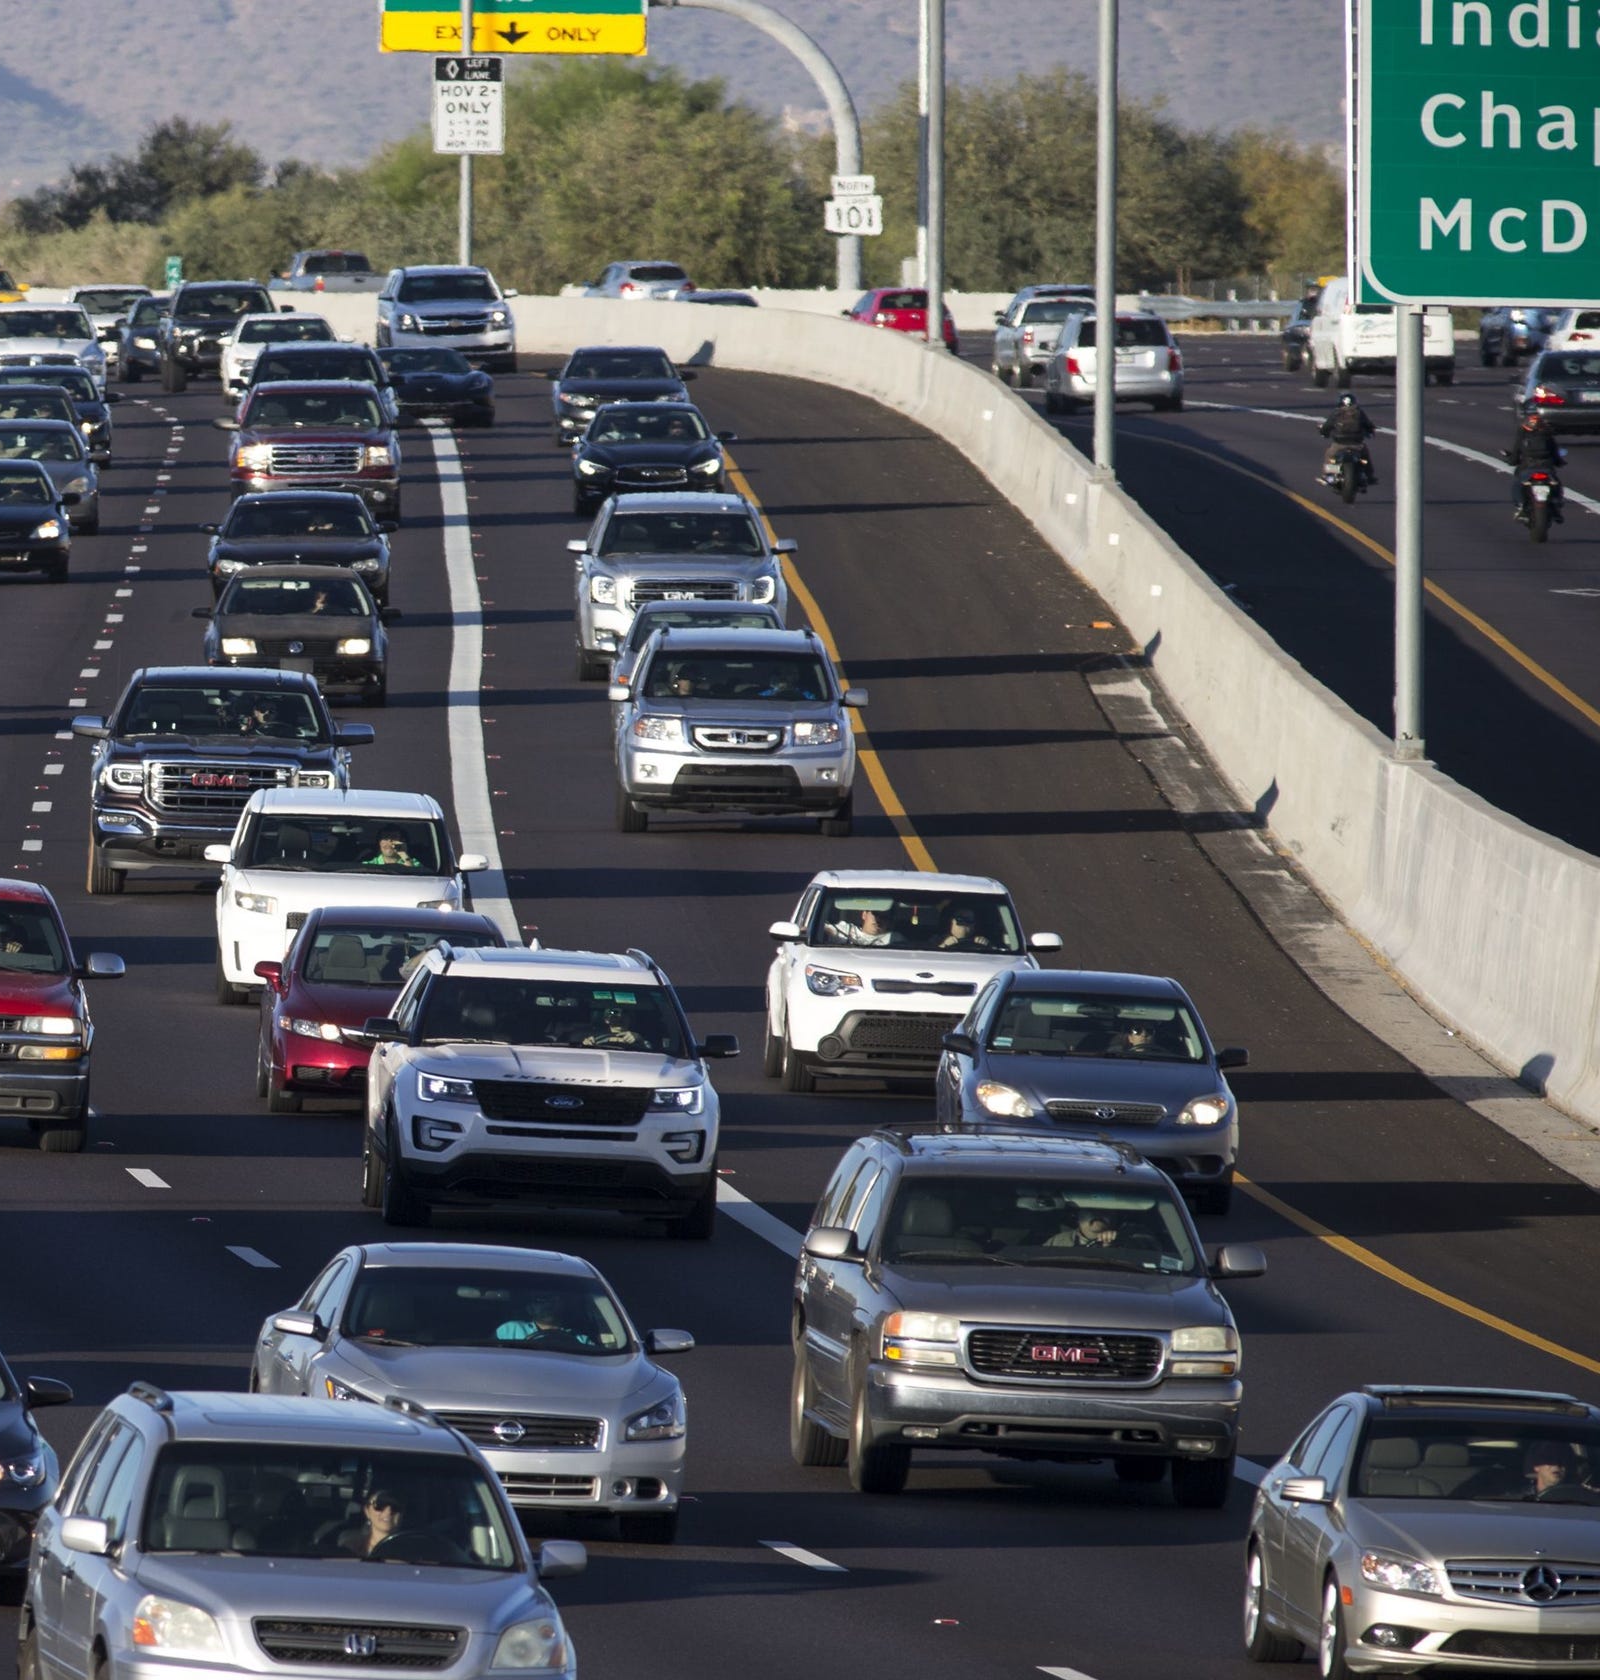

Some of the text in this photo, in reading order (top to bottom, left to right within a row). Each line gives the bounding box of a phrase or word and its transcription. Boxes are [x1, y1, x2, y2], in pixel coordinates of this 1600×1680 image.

[1420, 0, 1600, 49] Indi
[436, 26, 601, 41] EXT ONLY
[441, 85, 474, 96] HOV
[446, 102, 491, 113] ONLY
[836, 206, 873, 228] 101
[1420, 197, 1588, 253] McD
[191, 772, 250, 788] GMC
[1031, 1345, 1100, 1364] GMC
